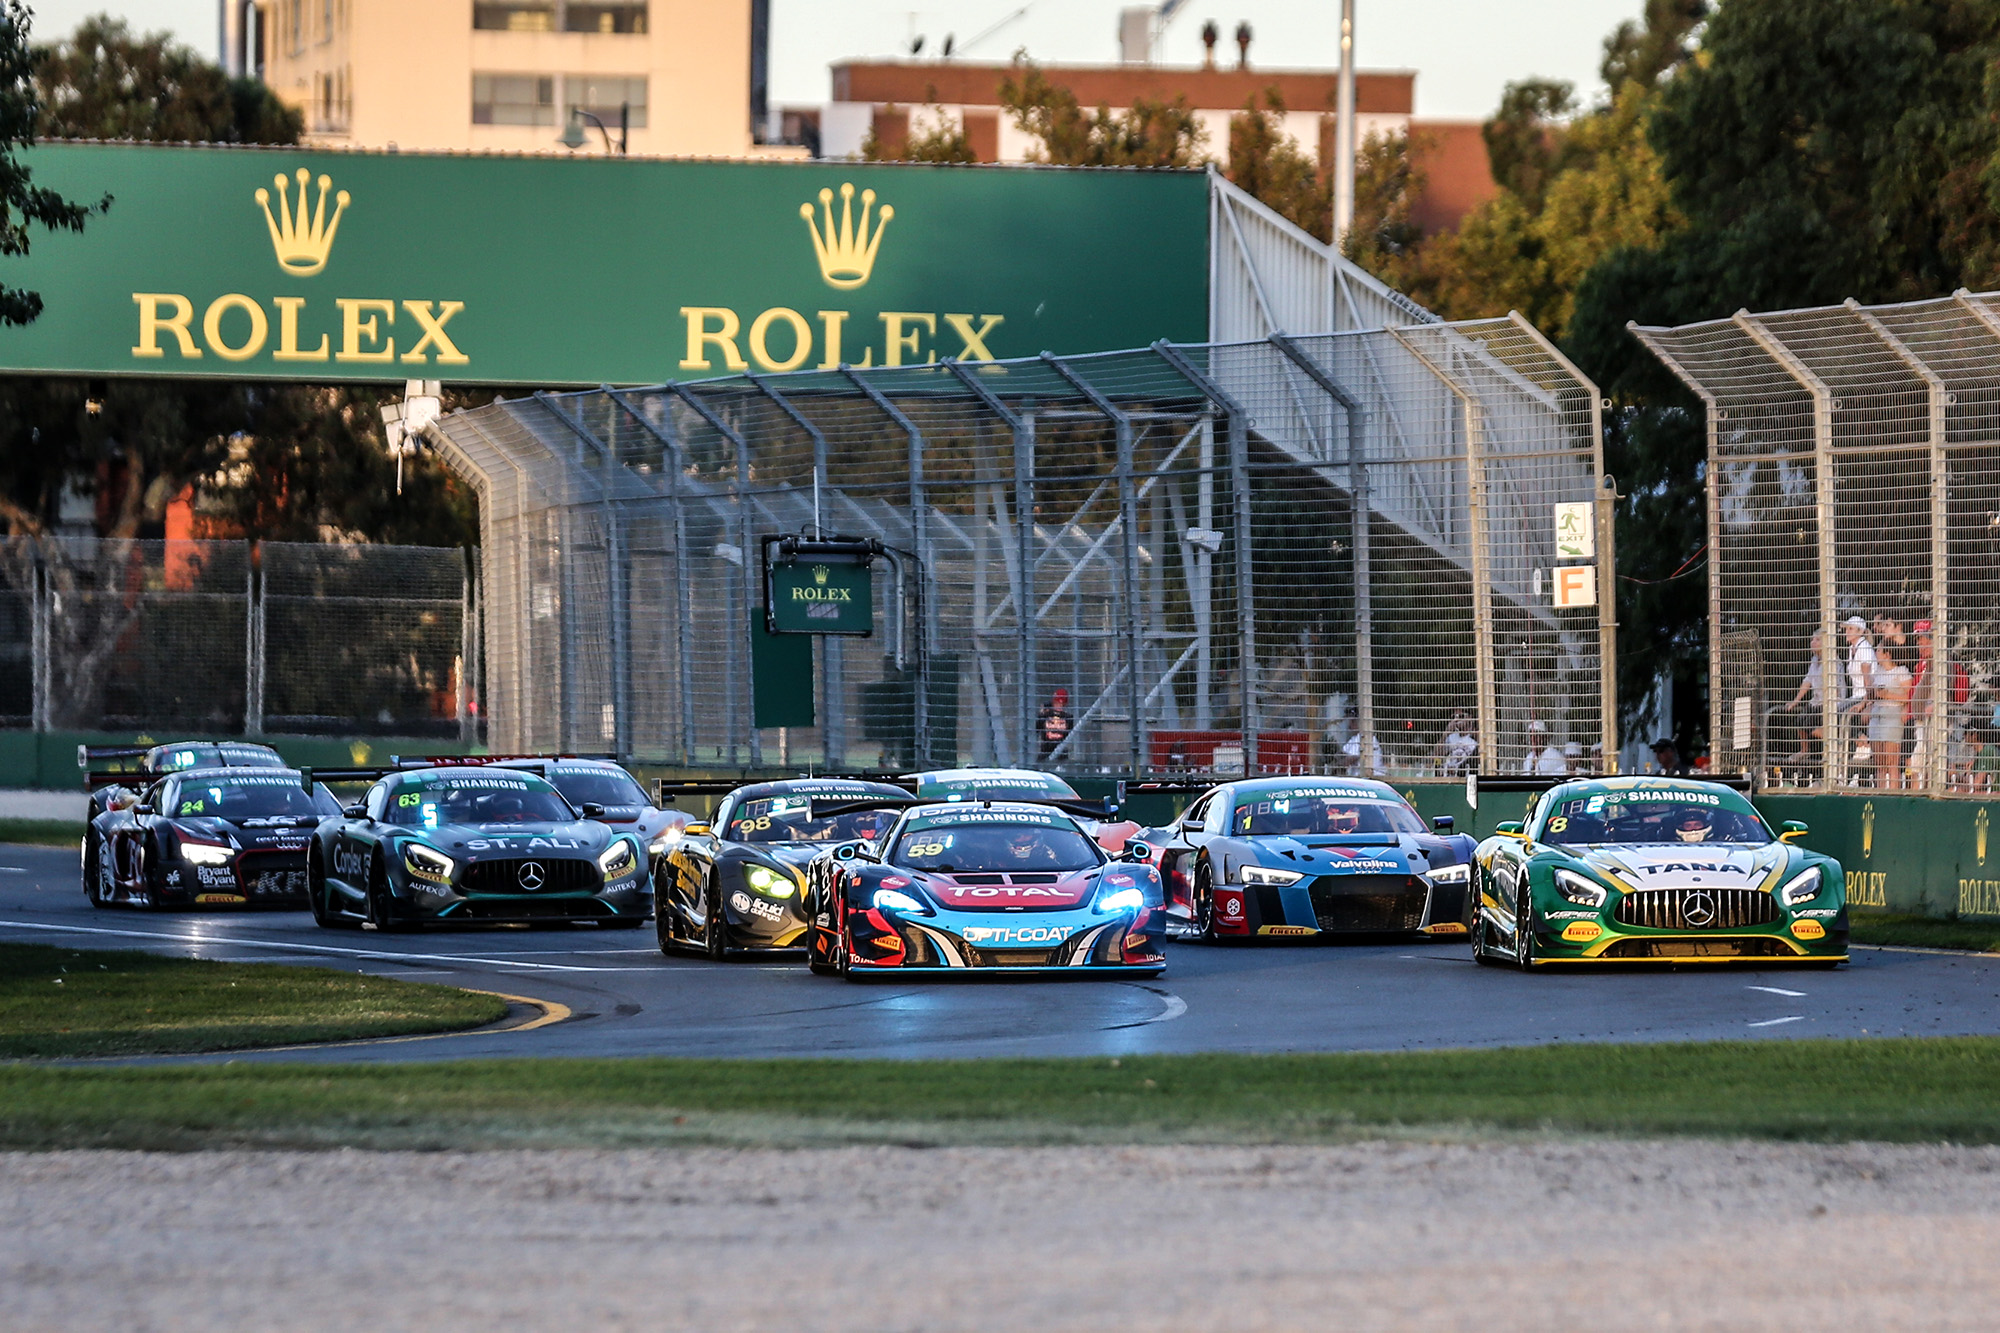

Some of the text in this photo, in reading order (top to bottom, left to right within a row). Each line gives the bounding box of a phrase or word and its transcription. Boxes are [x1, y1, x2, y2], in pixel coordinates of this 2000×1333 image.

[131, 292, 470, 364] ROLEX
[679, 306, 1009, 374] ROLEX
[1560, 568, 1585, 605] F
[791, 587, 852, 601] ROLEX
[556, 766, 625, 780] SHANNONS
[229, 777, 301, 787] SHANNONS
[450, 780, 527, 791] SHANNONS
[792, 785, 822, 793] PLUMB
[971, 779, 1049, 789] SHANNONS
[208, 787, 222, 805] 7
[398, 793, 421, 808] 63
[1293, 788, 1378, 799] SHANNONS
[1628, 791, 1720, 805] SHANNONS
[180, 799, 205, 816] 24
[921, 806, 1051, 817] OPTI-COAT
[1273, 799, 1290, 814] 4
[1586, 796, 1605, 814] 2
[740, 816, 772, 834] 98
[959, 813, 1051, 824] SHANNONS
[1242, 815, 1252, 830] 1
[1549, 817, 1569, 833] 8
[467, 837, 518, 850] ST.
[907, 843, 944, 858] 59
[1329, 859, 1398, 869] Valvoline
[1638, 862, 1747, 875] TANA
[197, 865, 231, 878] Bryant
[202, 874, 236, 886] Bryant
[255, 871, 309, 894] KF
[408, 881, 438, 895] AUTEX
[606, 882, 632, 894] AUTEX
[948, 886, 1075, 897] TOTAL
[1846, 871, 1887, 907] ROLEX
[1959, 879, 2000, 915] ROLEX
[752, 897, 785, 917] liquid
[963, 926, 1074, 942] OPTI-COAT
[1568, 927, 1599, 936] PIRELLI
[1793, 925, 1822, 934] PIRELLI
